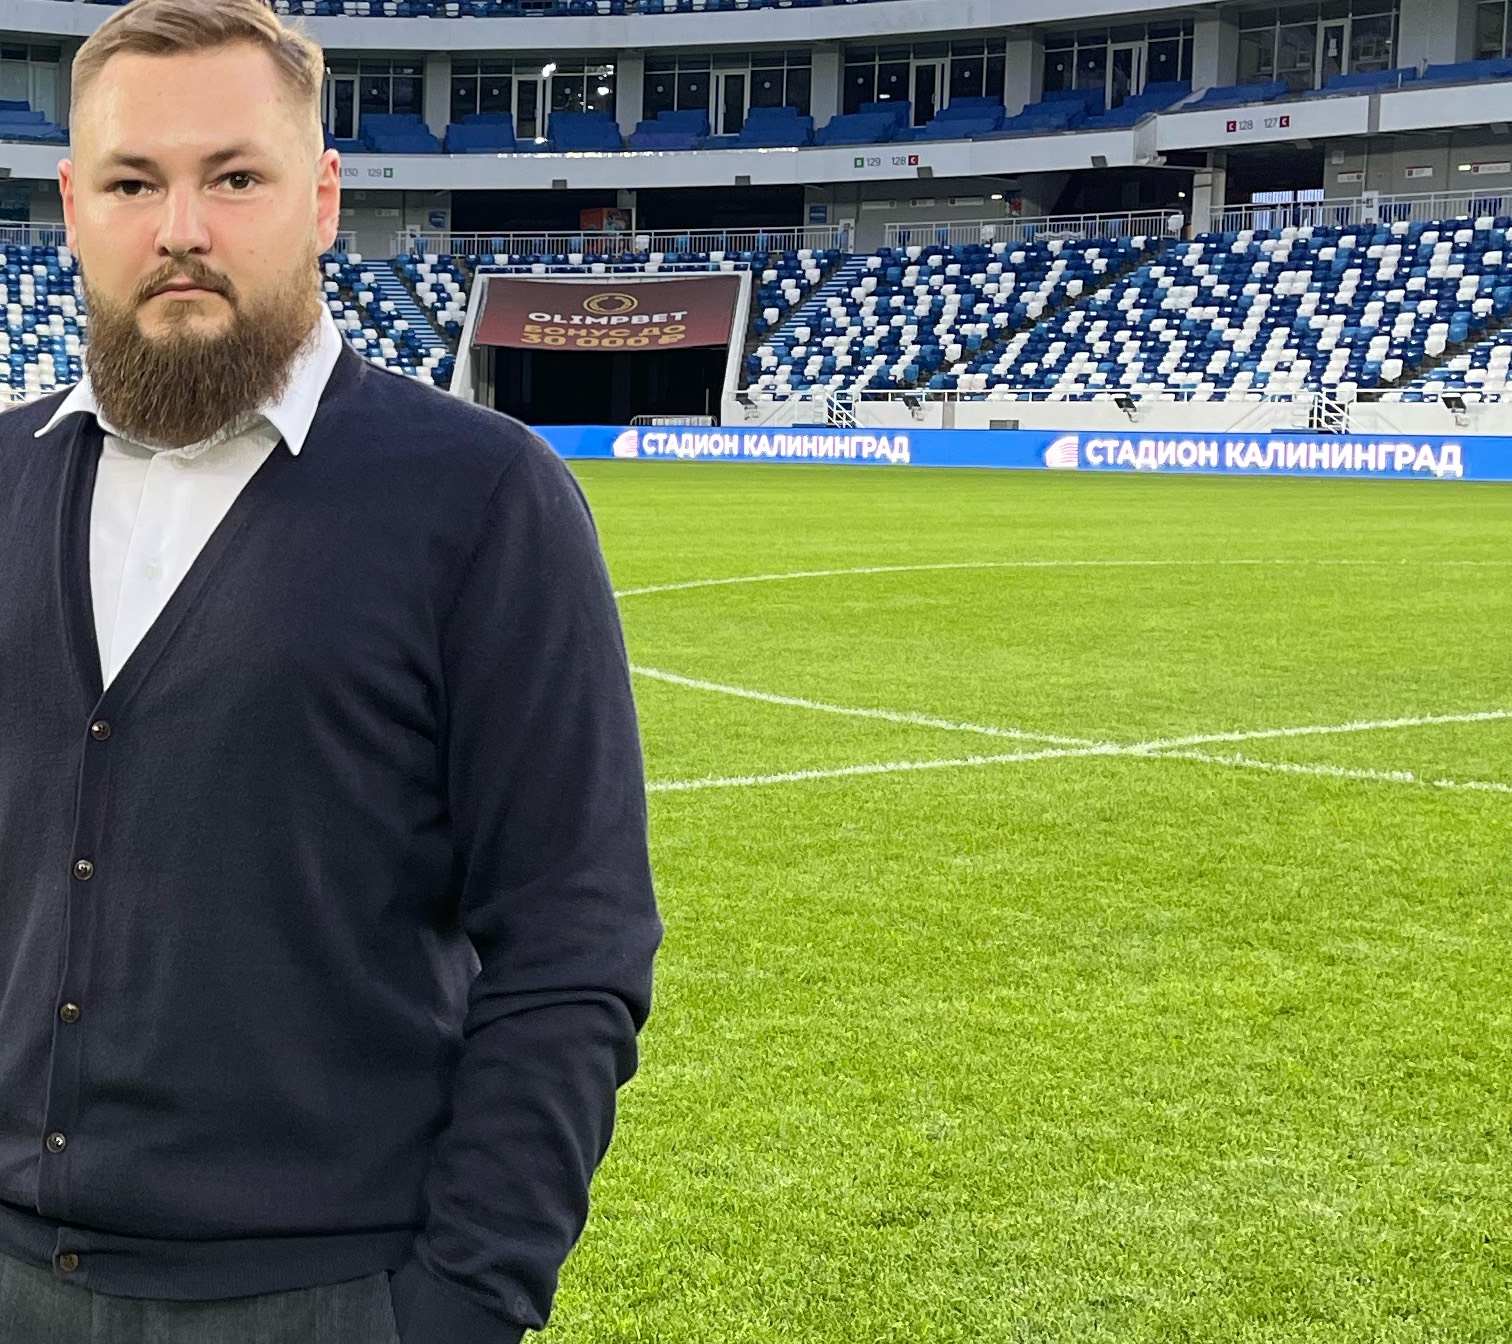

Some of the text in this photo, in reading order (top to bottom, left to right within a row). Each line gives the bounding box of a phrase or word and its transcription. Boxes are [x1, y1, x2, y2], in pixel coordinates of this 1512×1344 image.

[1239, 120, 1254, 131] 128
[1263, 117, 1278, 129] 127
[866, 157, 882, 167] 129
[891, 156, 907, 166] 128
[527, 311, 688, 326] OLIMPBET
[523, 324, 687, 337] БОНУС ДО
[520, 332, 567, 346] 30
[575, 336, 650, 347] 000
[642, 433, 910, 464] СТАДИОН КАЛИНИНГРАД
[1085, 440, 1465, 479] СТАДИОН КАЛИНИНГРАД
